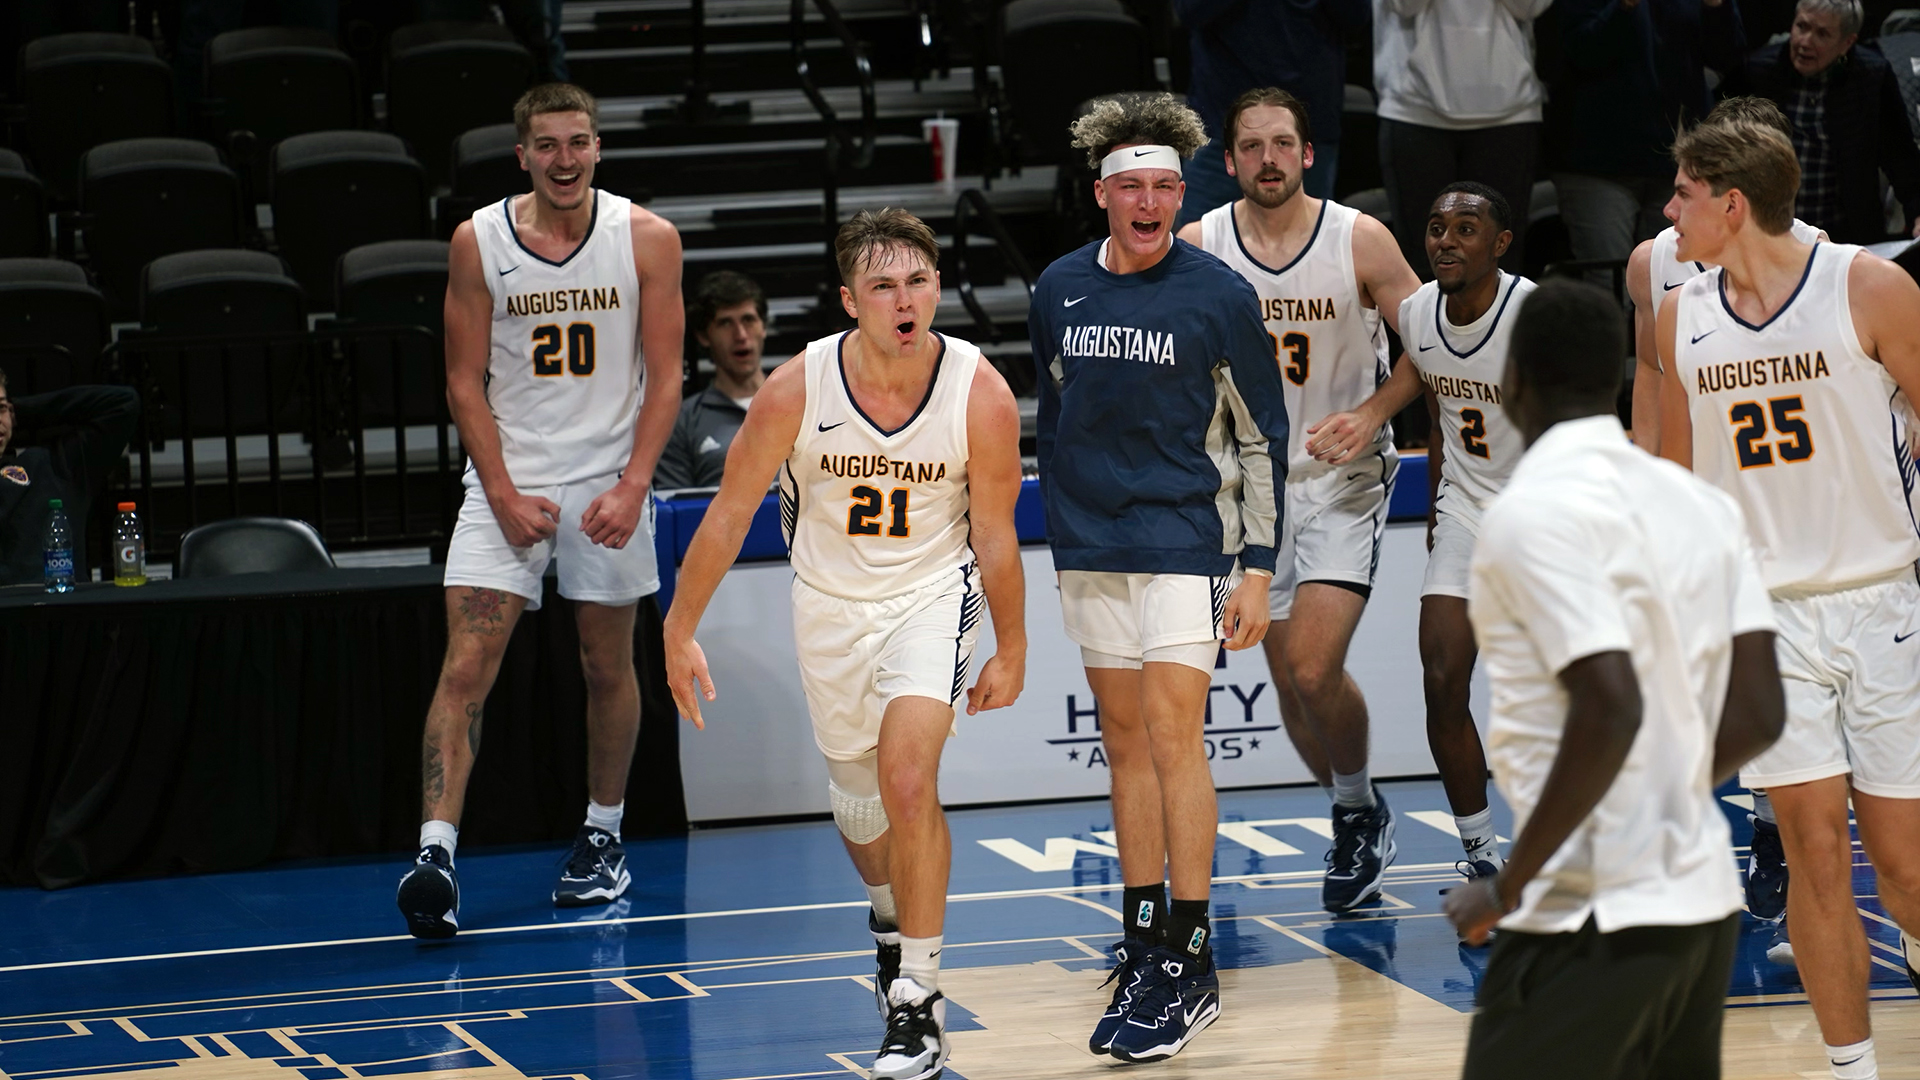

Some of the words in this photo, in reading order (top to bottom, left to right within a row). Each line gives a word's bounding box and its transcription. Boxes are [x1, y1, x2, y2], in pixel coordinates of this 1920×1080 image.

[507, 287, 619, 316] AUGUSTANA
[1259, 297, 1336, 322] USTANA
[532, 322, 595, 376] 20
[1062, 325, 1176, 366] AUGUSTANA
[1268, 331, 1310, 387] 3
[1698, 351, 1829, 394] AUGUSTANA
[1459, 406, 1491, 460] 2
[1729, 395, 1816, 470] 25
[820, 454, 946, 483] AUGUSTANA
[847, 485, 910, 538] 21
[47, 558, 73, 569] 100%
